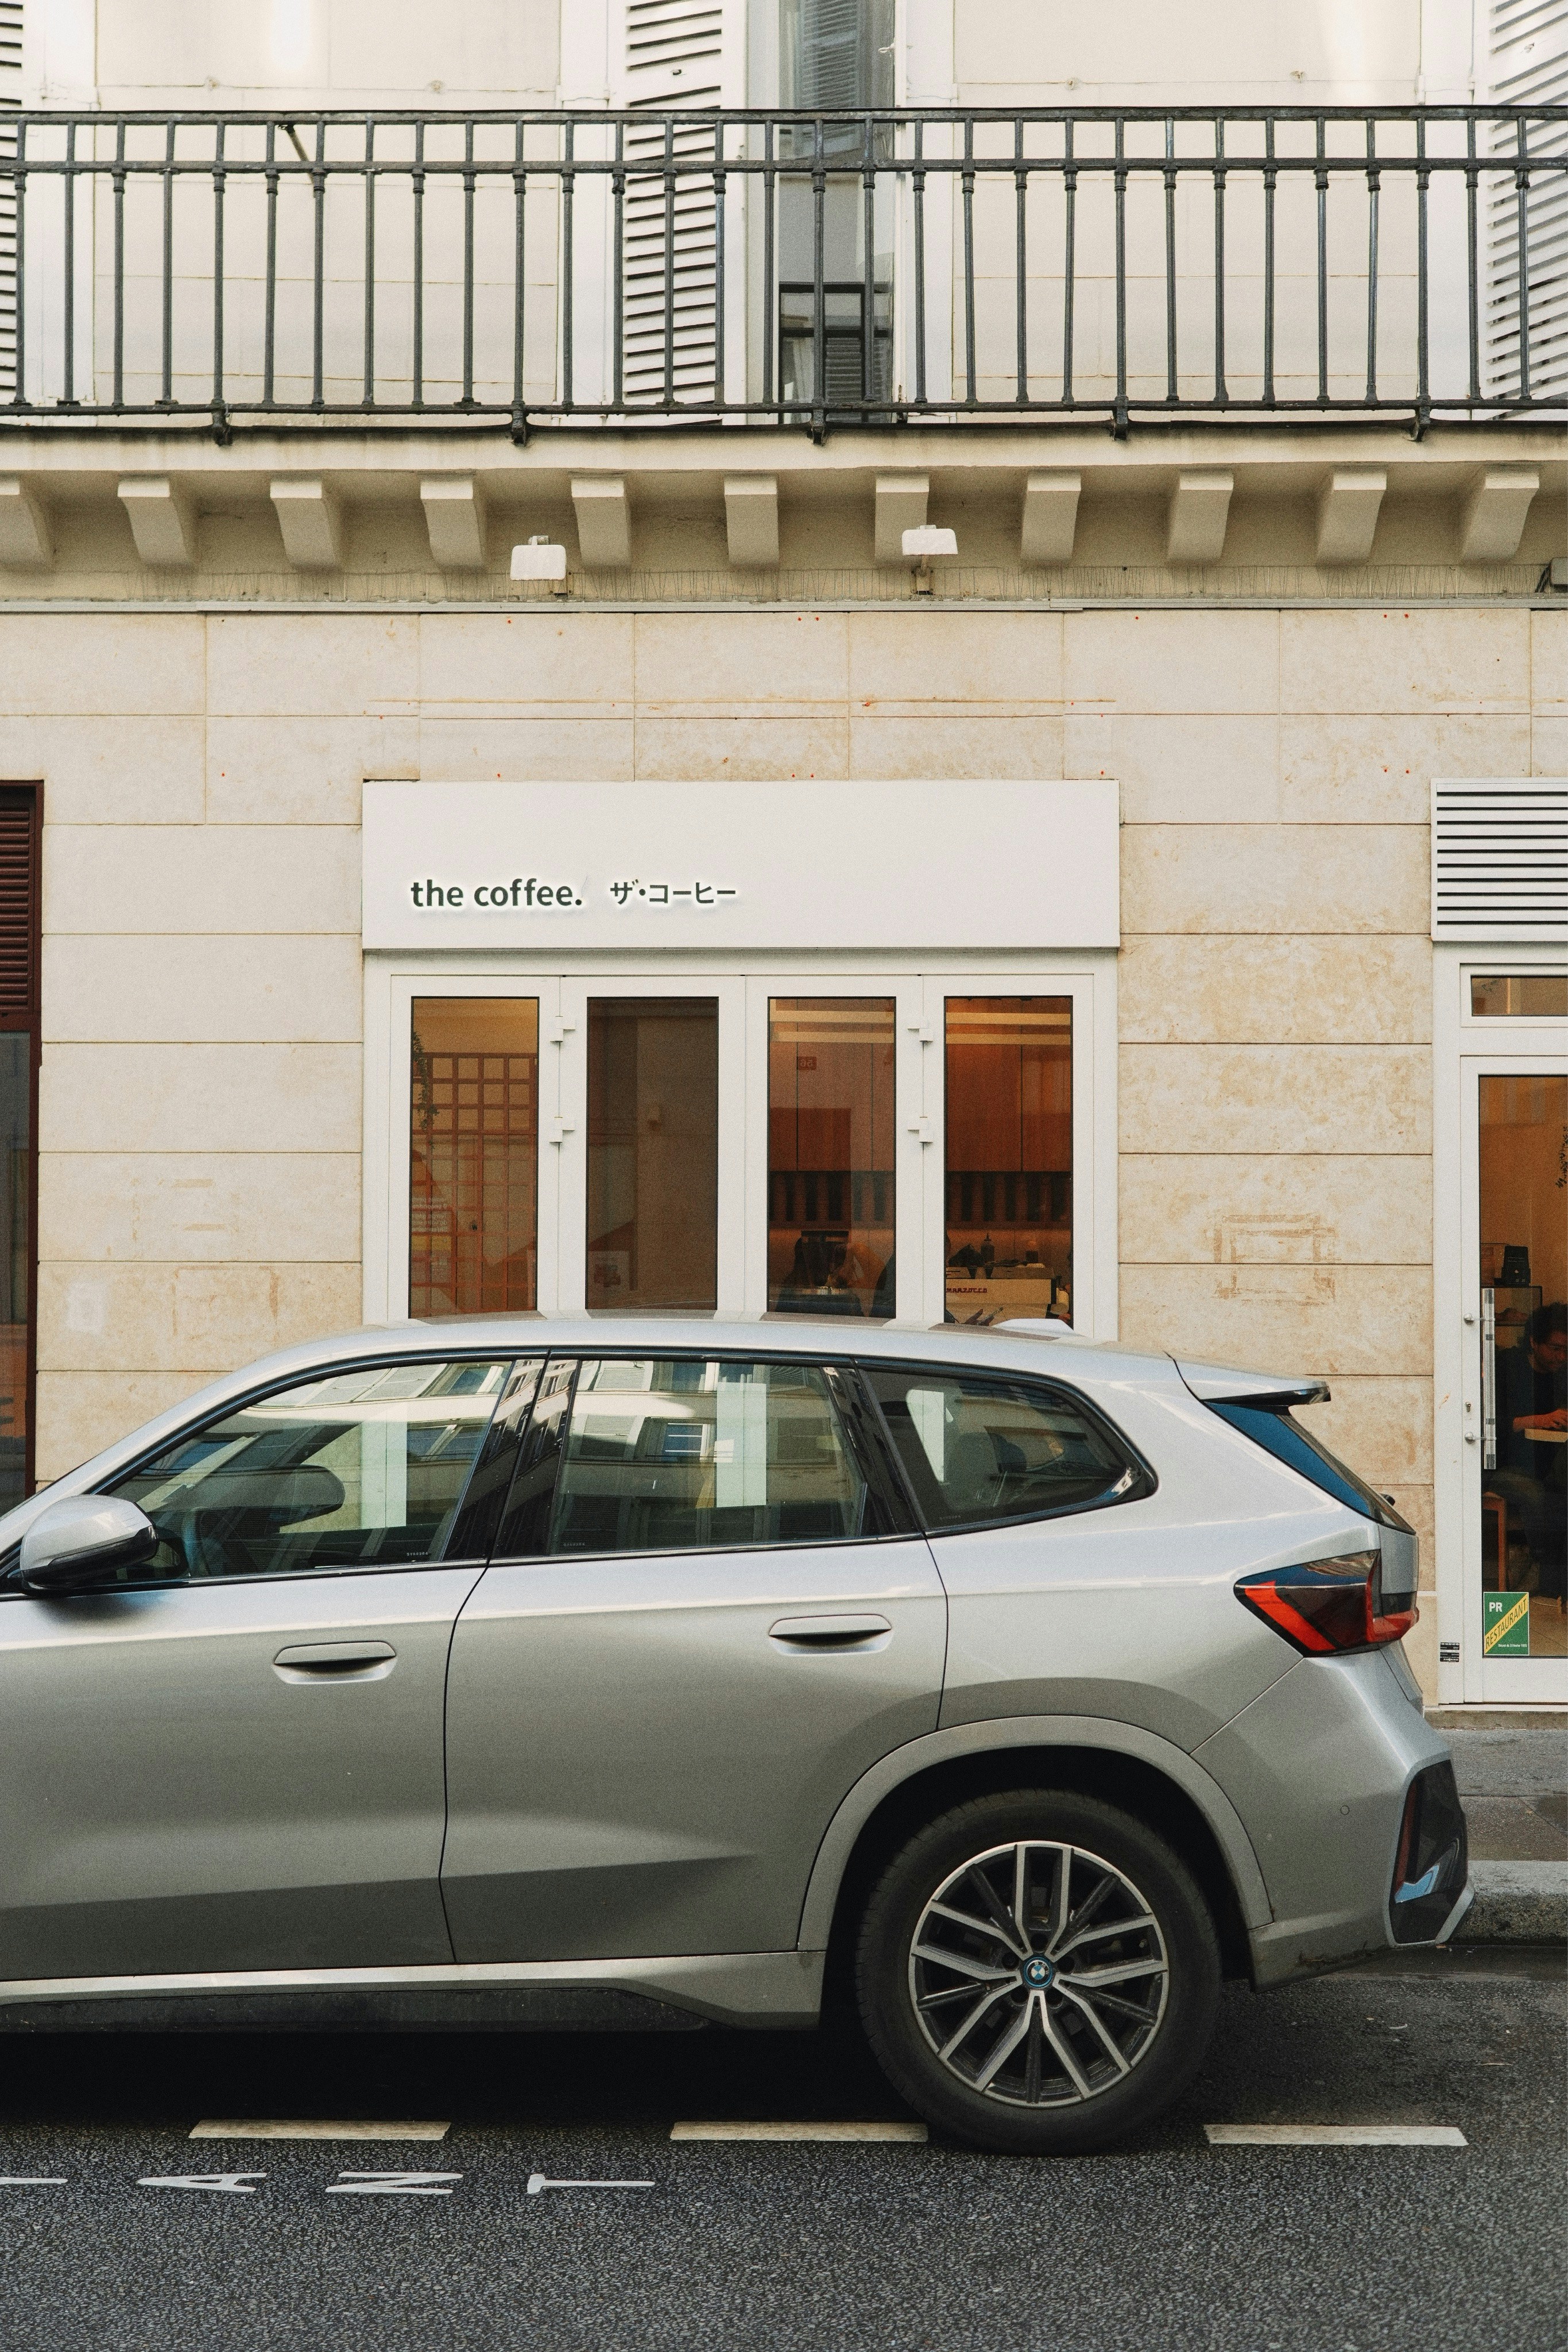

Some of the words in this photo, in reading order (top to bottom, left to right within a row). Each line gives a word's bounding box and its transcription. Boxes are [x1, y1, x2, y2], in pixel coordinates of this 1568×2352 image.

[411, 879, 463, 907] the
[474, 878, 582, 907] coffee.
[610, 879, 736, 904] ザ・コーヒー
[1489, 1602, 1503, 1612] PR
[1486, 1598, 1527, 1649] RESTAURANT
